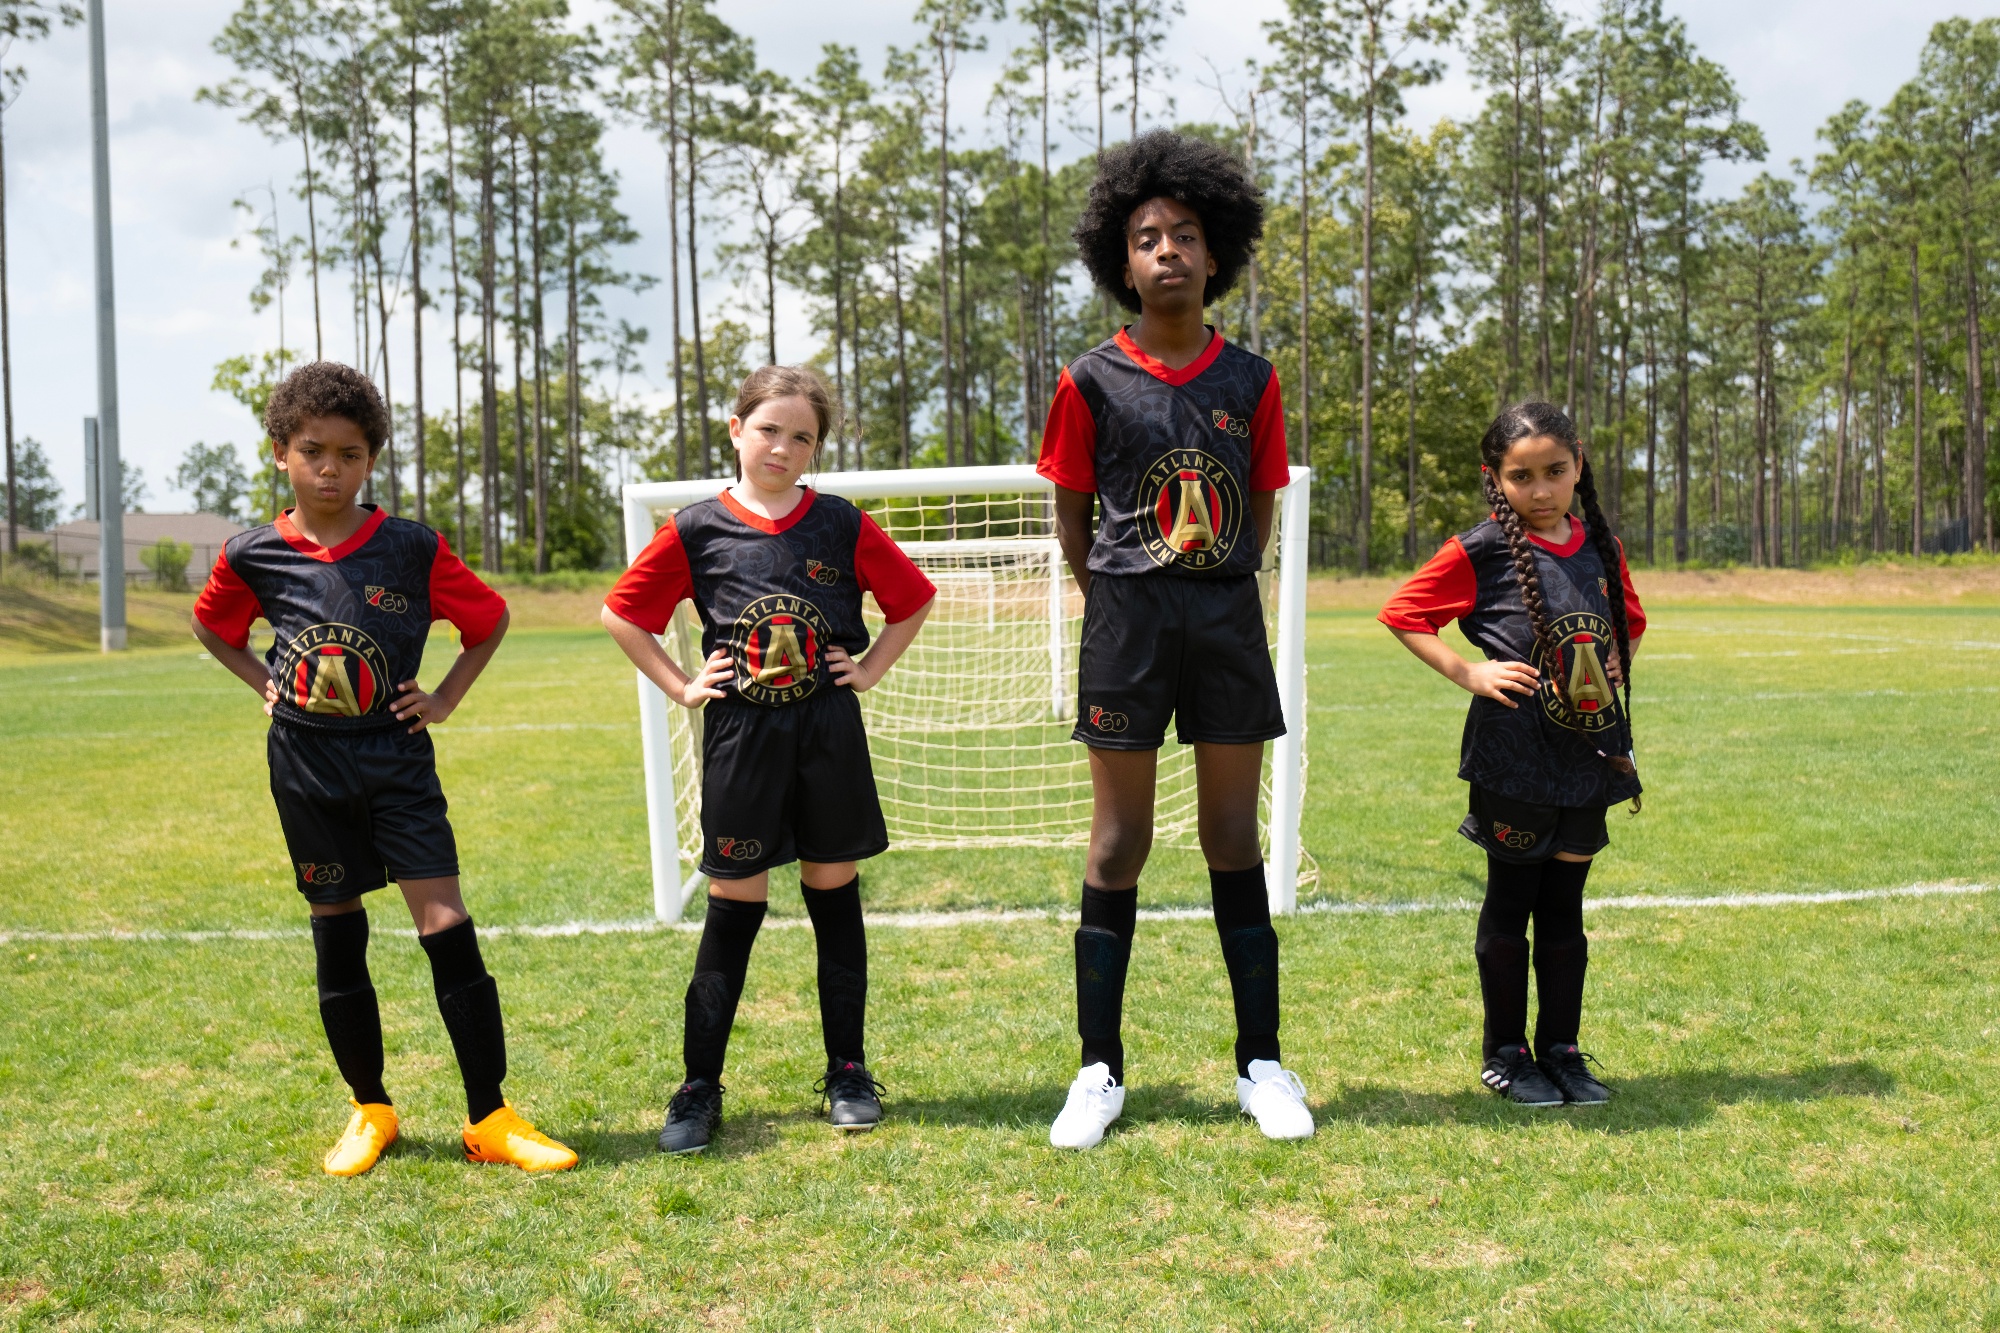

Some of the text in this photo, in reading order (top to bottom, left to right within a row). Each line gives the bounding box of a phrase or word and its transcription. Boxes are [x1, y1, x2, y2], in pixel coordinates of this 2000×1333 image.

[1150, 453, 1225, 487] ATLANTA
[1168, 480, 1215, 553] A
[1150, 538, 1229, 566] UNIED FC
[815, 566, 840, 587] GO
[378, 592, 408, 614] GO
[740, 598, 820, 630] ATLANTA
[1553, 617, 1611, 646] TLANTA
[756, 624, 808, 686] A
[304, 655, 362, 716] A
[1567, 643, 1614, 712] A
[1098, 711, 1129, 733] GO
[728, 838, 762, 860] GO
[1503, 830, 1537, 850] GO
[310, 862, 345, 885] GO
